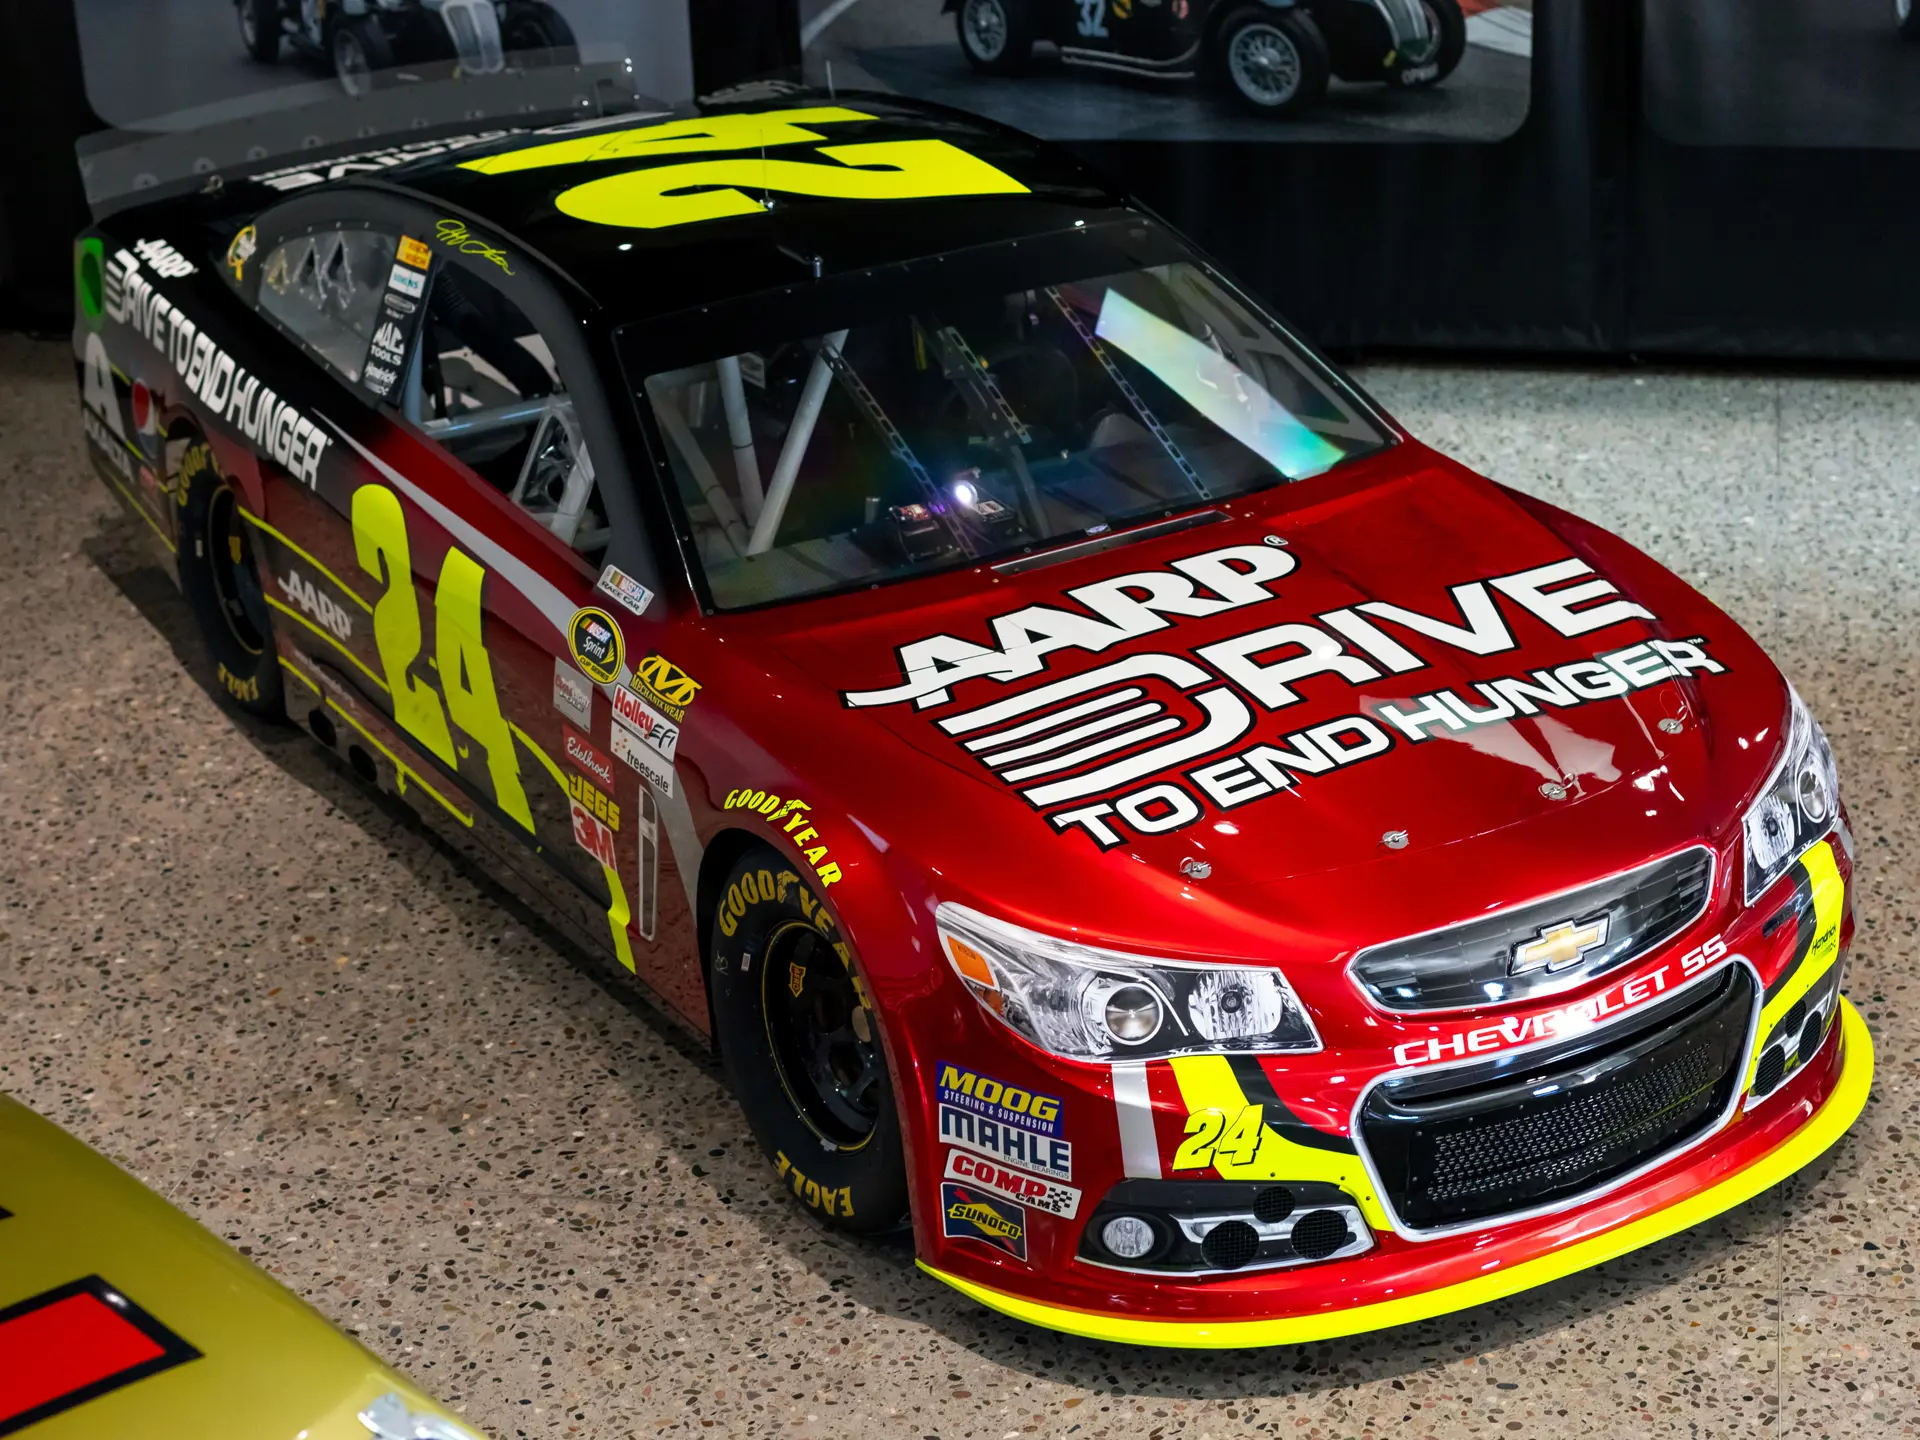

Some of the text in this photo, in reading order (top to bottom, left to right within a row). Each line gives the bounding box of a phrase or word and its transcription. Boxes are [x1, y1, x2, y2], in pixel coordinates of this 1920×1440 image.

[456, 107, 1031, 229] 24
[370, 344, 402, 366] TOOLS
[372, 322, 405, 355] MAC
[166, 306, 196, 376] TO
[185, 332, 236, 414] END
[226, 367, 329, 492] HUNGER
[277, 569, 352, 641] AARP
[600, 580, 641, 612] RACE CAR
[352, 483, 536, 836] 24
[579, 656, 591, 669] CUP
[583, 636, 606, 660] Sprint
[932, 556, 1660, 812] DRIVE
[614, 686, 654, 740] Holley
[662, 702, 686, 724] WEAR
[567, 736, 611, 784] Edelbrock
[1045, 638, 1728, 852] TO END HUNGER
[626, 749, 670, 793] freescale
[568, 772, 620, 832] JEGS
[572, 805, 617, 873] 3M
[723, 788, 843, 889] GOODYEAR
[1681, 933, 1728, 978] SS
[939, 1065, 1060, 1122] MOOG
[943, 1089, 1054, 1134] STEERING & SUSPENSION
[941, 1105, 1070, 1173] MAHLE
[1172, 1103, 1264, 1171] 24
[772, 1149, 855, 1217] EAGLE
[952, 1154, 1048, 1198] COMP
[1003, 1154, 1070, 1180] ENGINE BEARINGS
[951, 1205, 1021, 1239] SUNOCO
[1015, 1192, 1062, 1214] CAMS
